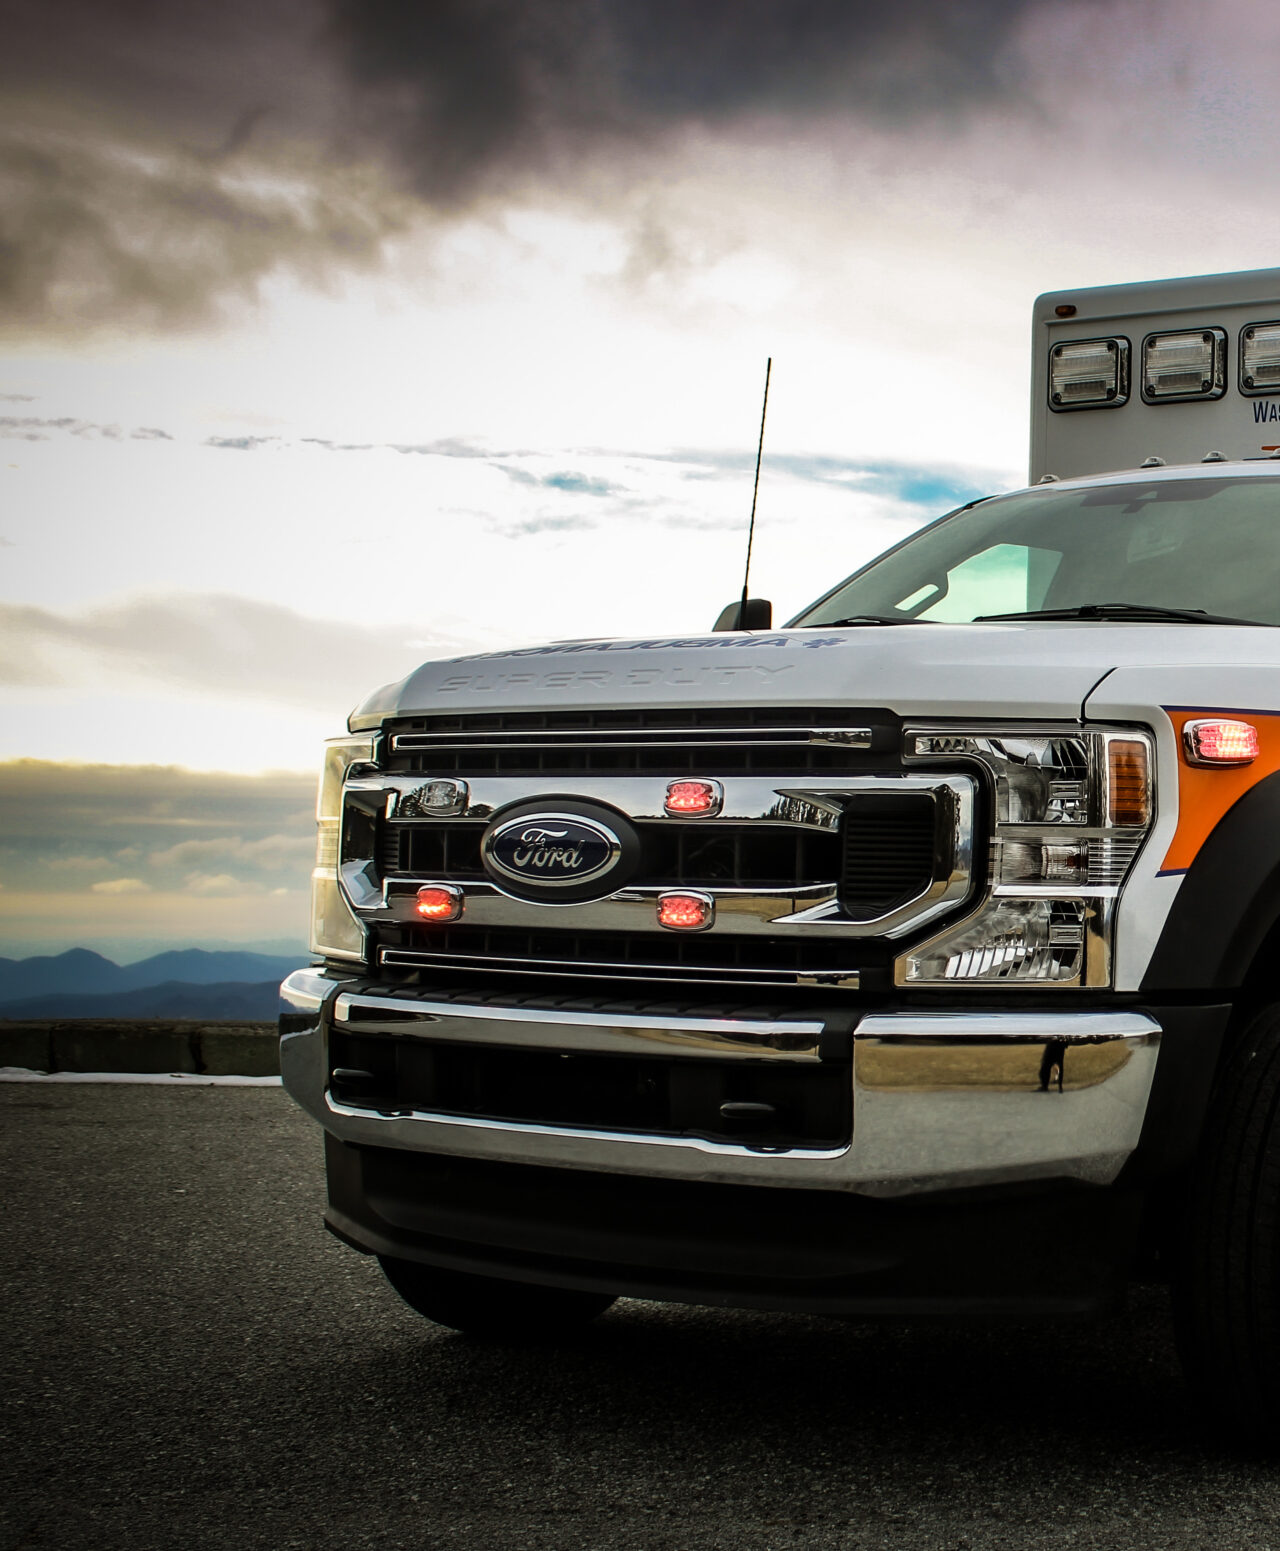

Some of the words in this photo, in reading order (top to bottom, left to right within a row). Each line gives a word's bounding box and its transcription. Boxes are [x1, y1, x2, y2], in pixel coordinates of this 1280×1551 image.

[437, 671, 613, 693] SUPER
[620, 665, 795, 688] DUTY
[513, 828, 586, 868] Ford
